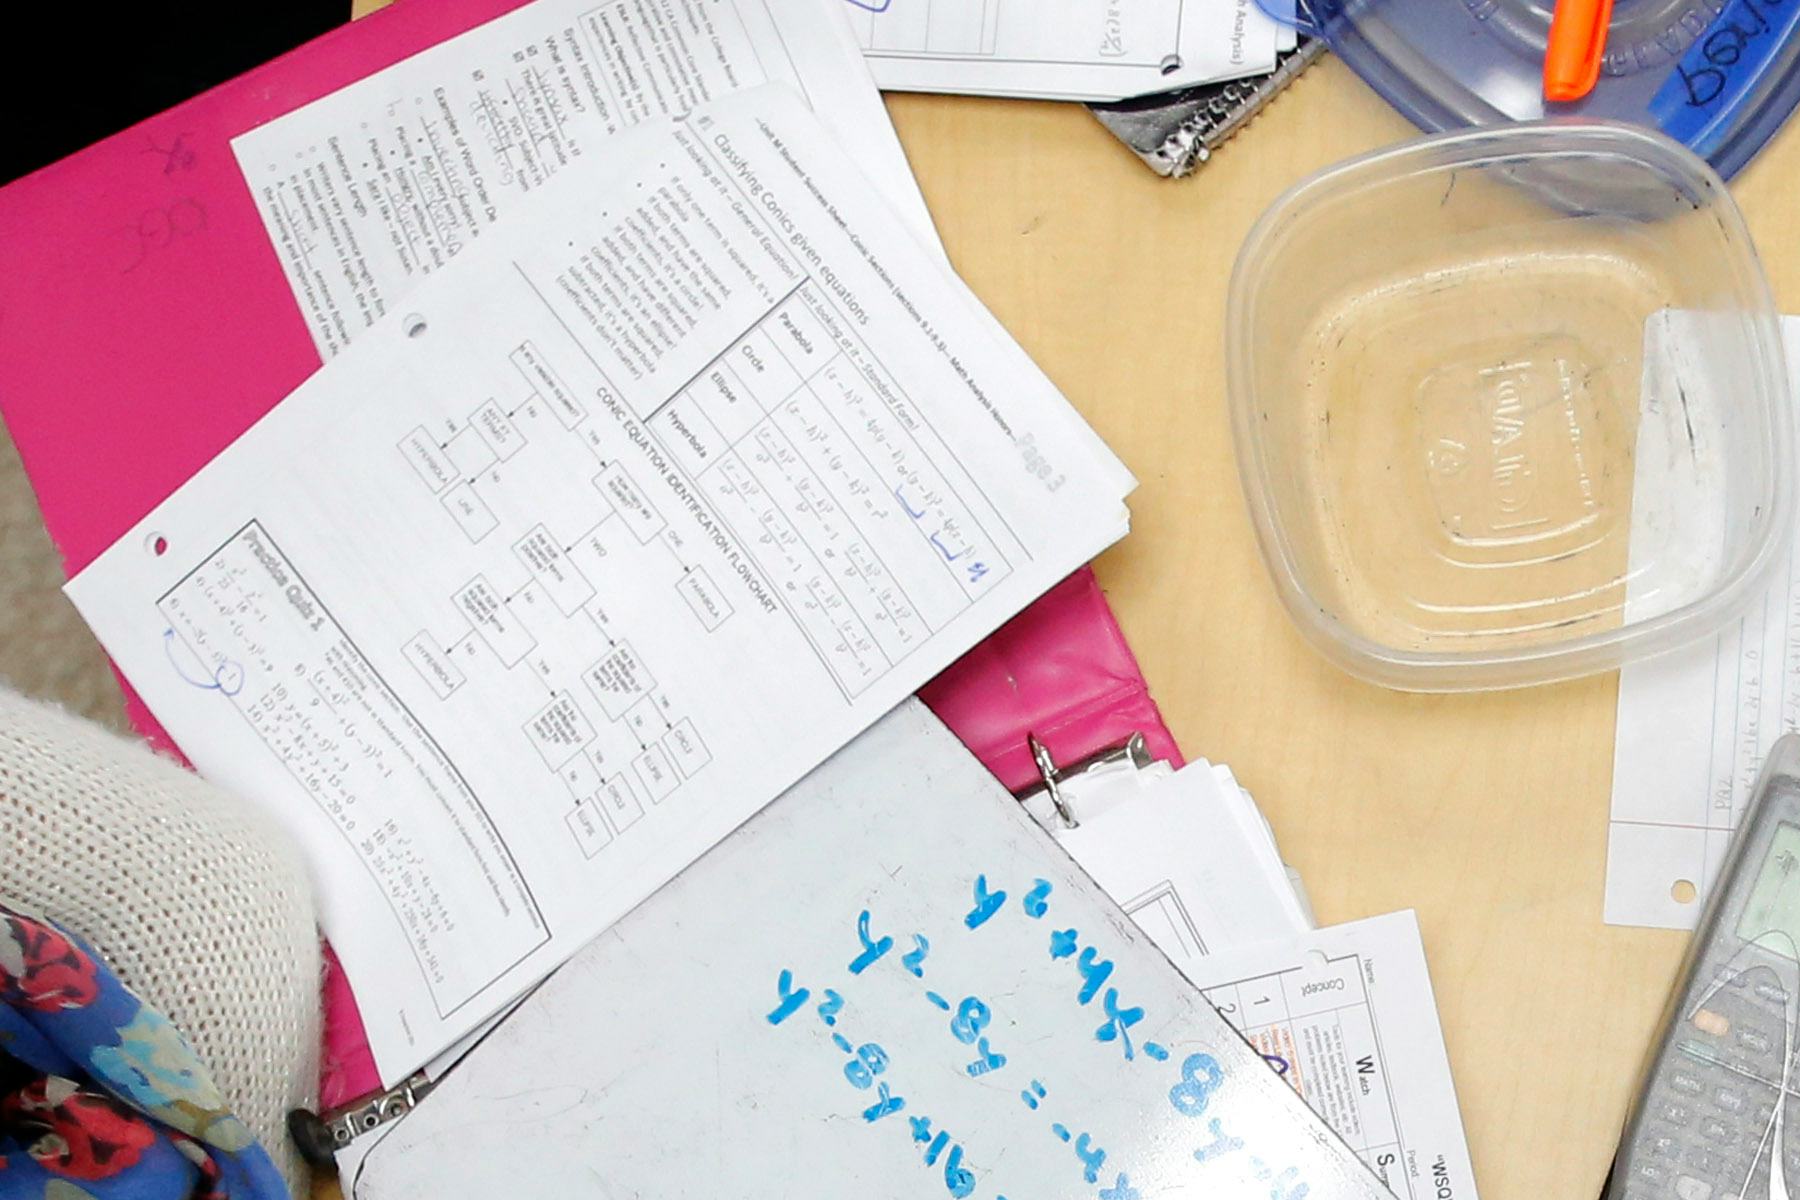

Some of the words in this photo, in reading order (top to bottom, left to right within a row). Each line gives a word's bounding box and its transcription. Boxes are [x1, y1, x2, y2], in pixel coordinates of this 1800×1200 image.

[1228, 9, 1247, 66] Analysis)
[544, 35, 563, 64] What
[556, 64, 566, 75] is
[561, 75, 586, 112] syntax?
[432, 86, 460, 136] Examples
[454, 136, 467, 147] of
[459, 147, 478, 176] Word
[327, 135, 352, 182] Sentence
[346, 181, 367, 218] Length
[472, 176, 490, 205] Order
[713, 133, 764, 196] Classifying
[760, 191, 795, 234] Conics
[788, 231, 822, 267] given
[818, 265, 870, 326] equations
[777, 311, 813, 354] Parabola
[740, 344, 765, 373] Circle
[709, 370, 737, 403] Ellipse
[666, 408, 707, 458] Hyperbola
[595, 386, 626, 421] CONIC
[621, 418, 670, 476] EQUATION
[664, 472, 732, 554] IDENTIFICATION
[726, 551, 778, 614] FLOWCHART
[1300, 977, 1345, 997] Concept
[1354, 1054, 1375, 1096] Watch
